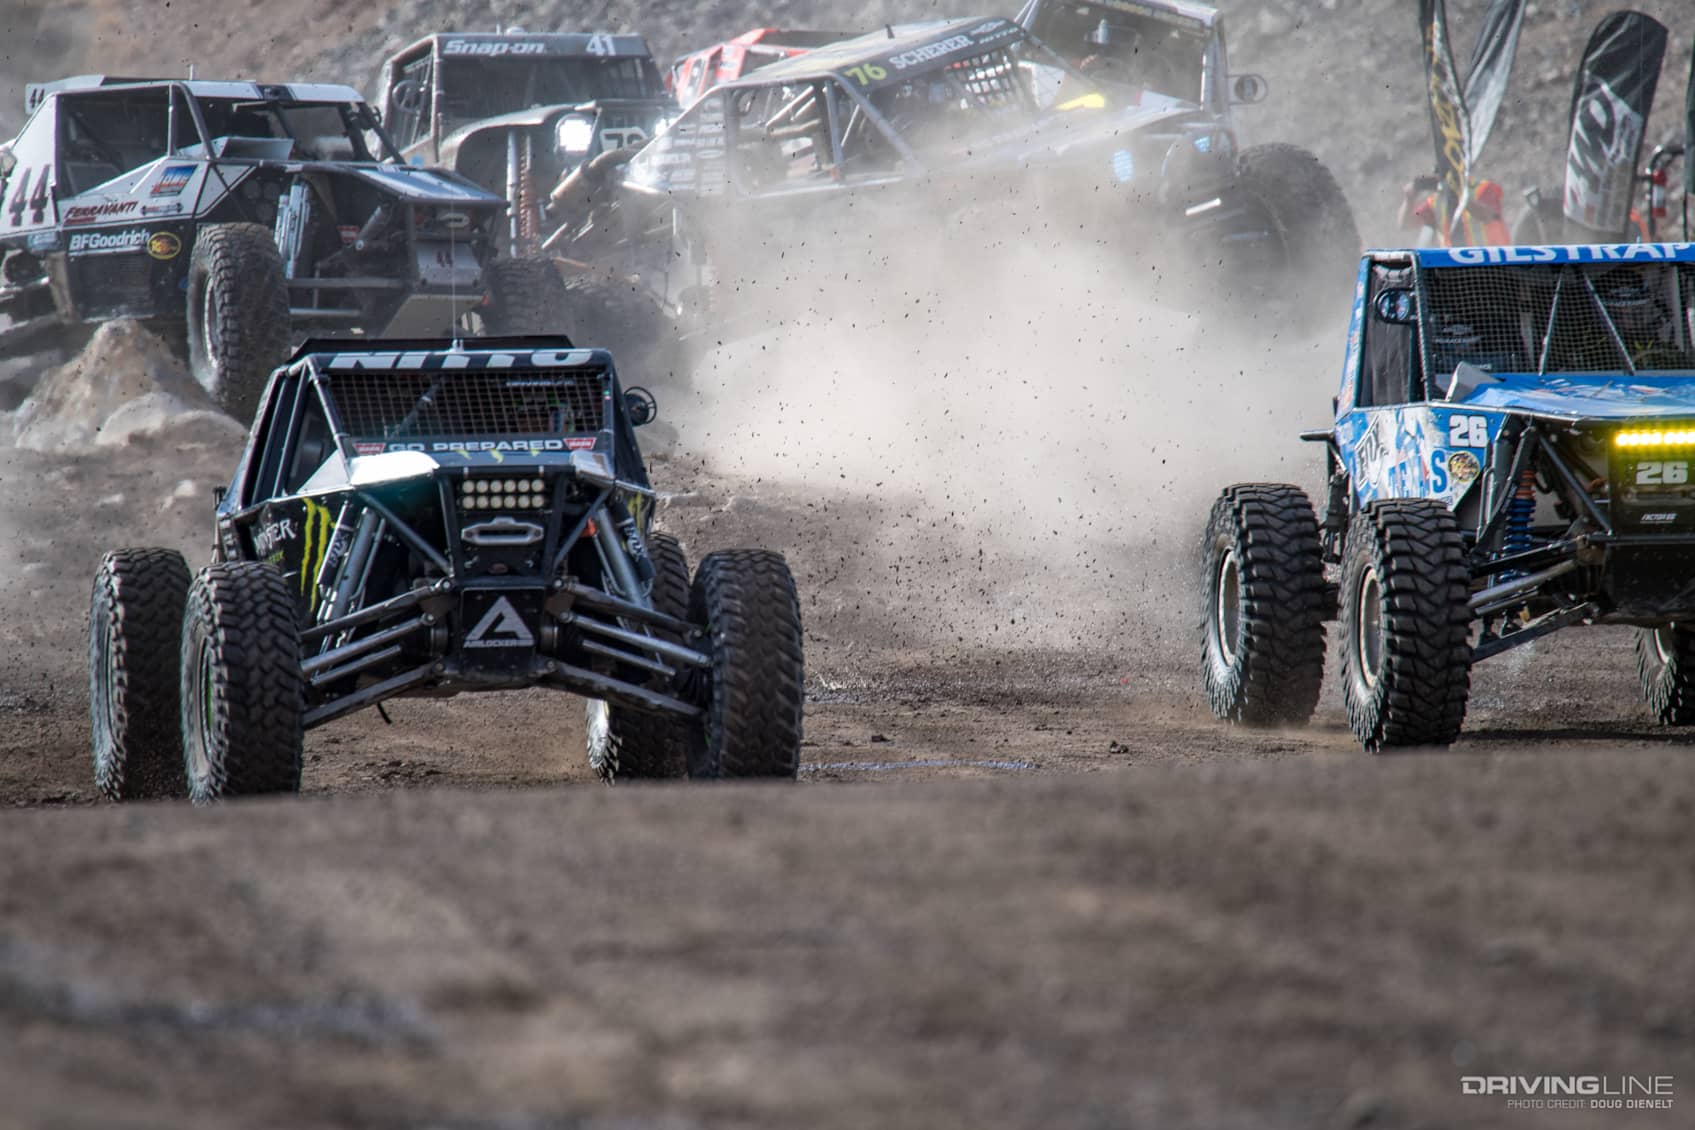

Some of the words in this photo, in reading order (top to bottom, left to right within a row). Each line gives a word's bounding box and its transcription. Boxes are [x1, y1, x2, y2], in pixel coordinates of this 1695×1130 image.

[443, 39, 545, 57] Snap-on
[586, 34, 616, 57] 41
[889, 34, 975, 70] SCHERER
[844, 63, 887, 87] 76
[9, 164, 50, 227] 44
[69, 228, 150, 250] BFGoodrich
[1449, 415, 1488, 448] 26
[432, 439, 563, 452] PREPARED
[1636, 461, 1689, 485] 26
